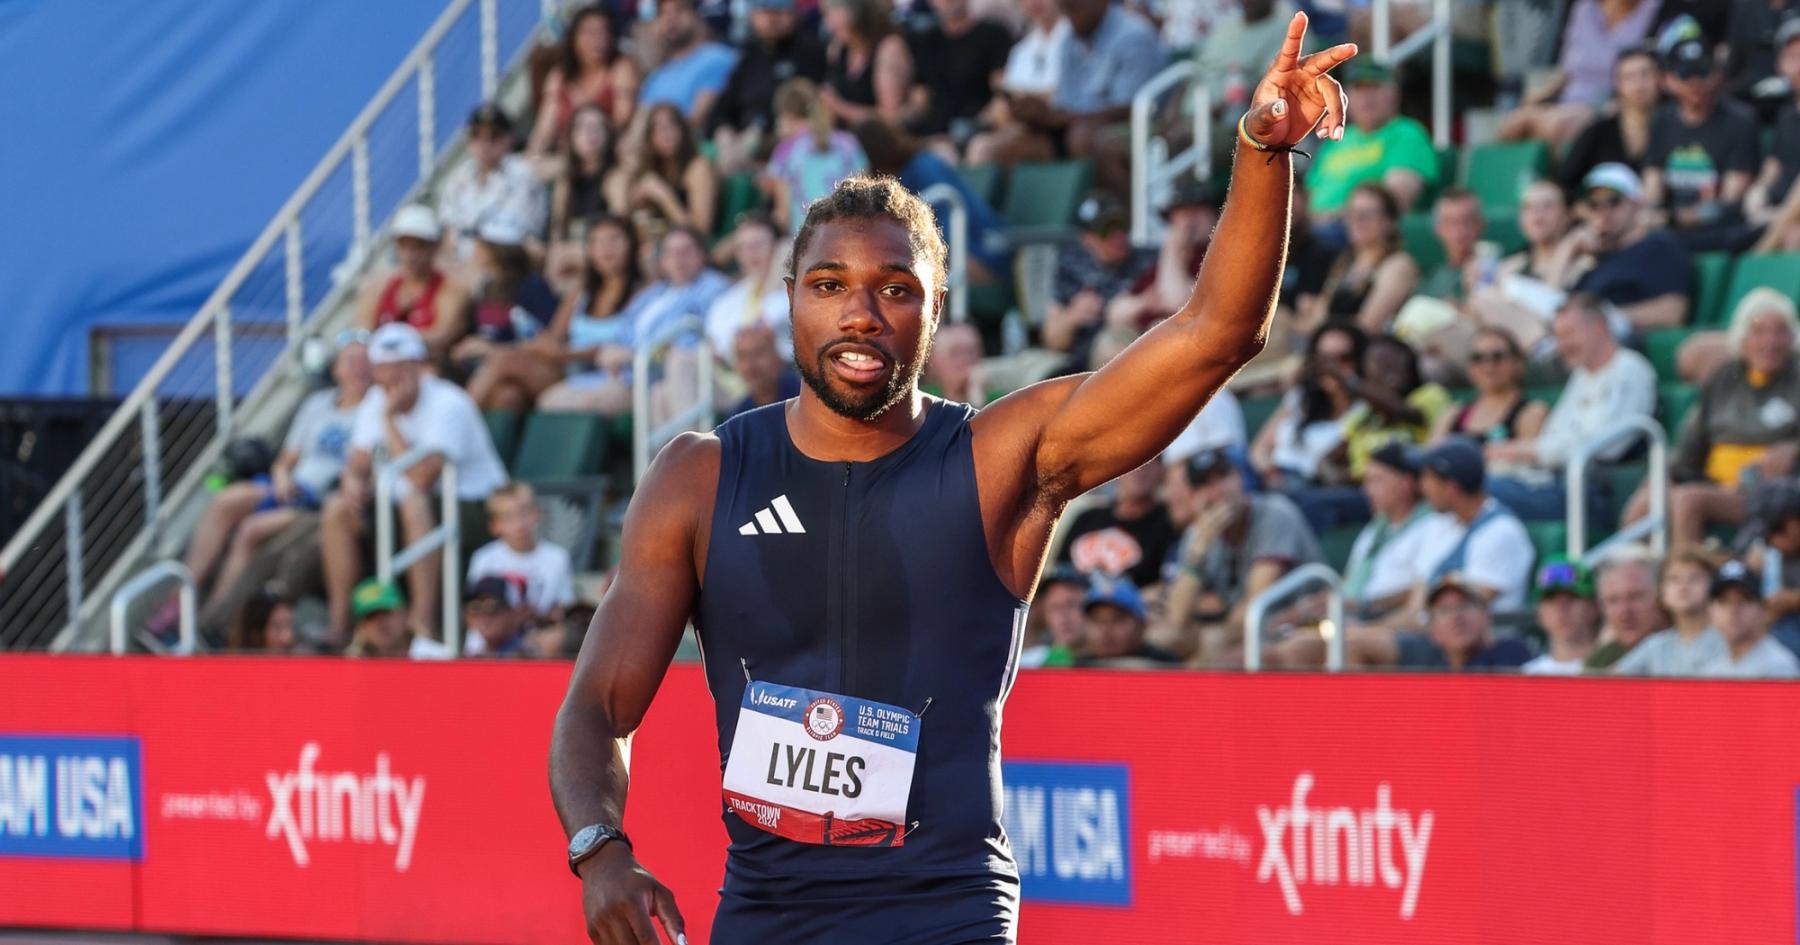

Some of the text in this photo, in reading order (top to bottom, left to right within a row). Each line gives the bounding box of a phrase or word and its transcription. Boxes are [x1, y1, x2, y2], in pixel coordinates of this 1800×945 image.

[763, 695, 798, 709] USATF
[858, 716, 909, 735] TEAM TRIALS
[859, 705, 910, 724] U.S. OLYMPIC
[857, 727, 875, 737] TRACK
[880, 731, 895, 740] FIELD
[767, 742, 866, 799] LYLES
[56, 756, 134, 839] USA
[266, 742, 426, 872] xfinity
[730, 797, 781, 820] TRACKTOWN
[758, 814, 778, 829] 2024
[1052, 788, 1124, 881] USA
[1256, 772, 1435, 920] xfinity
